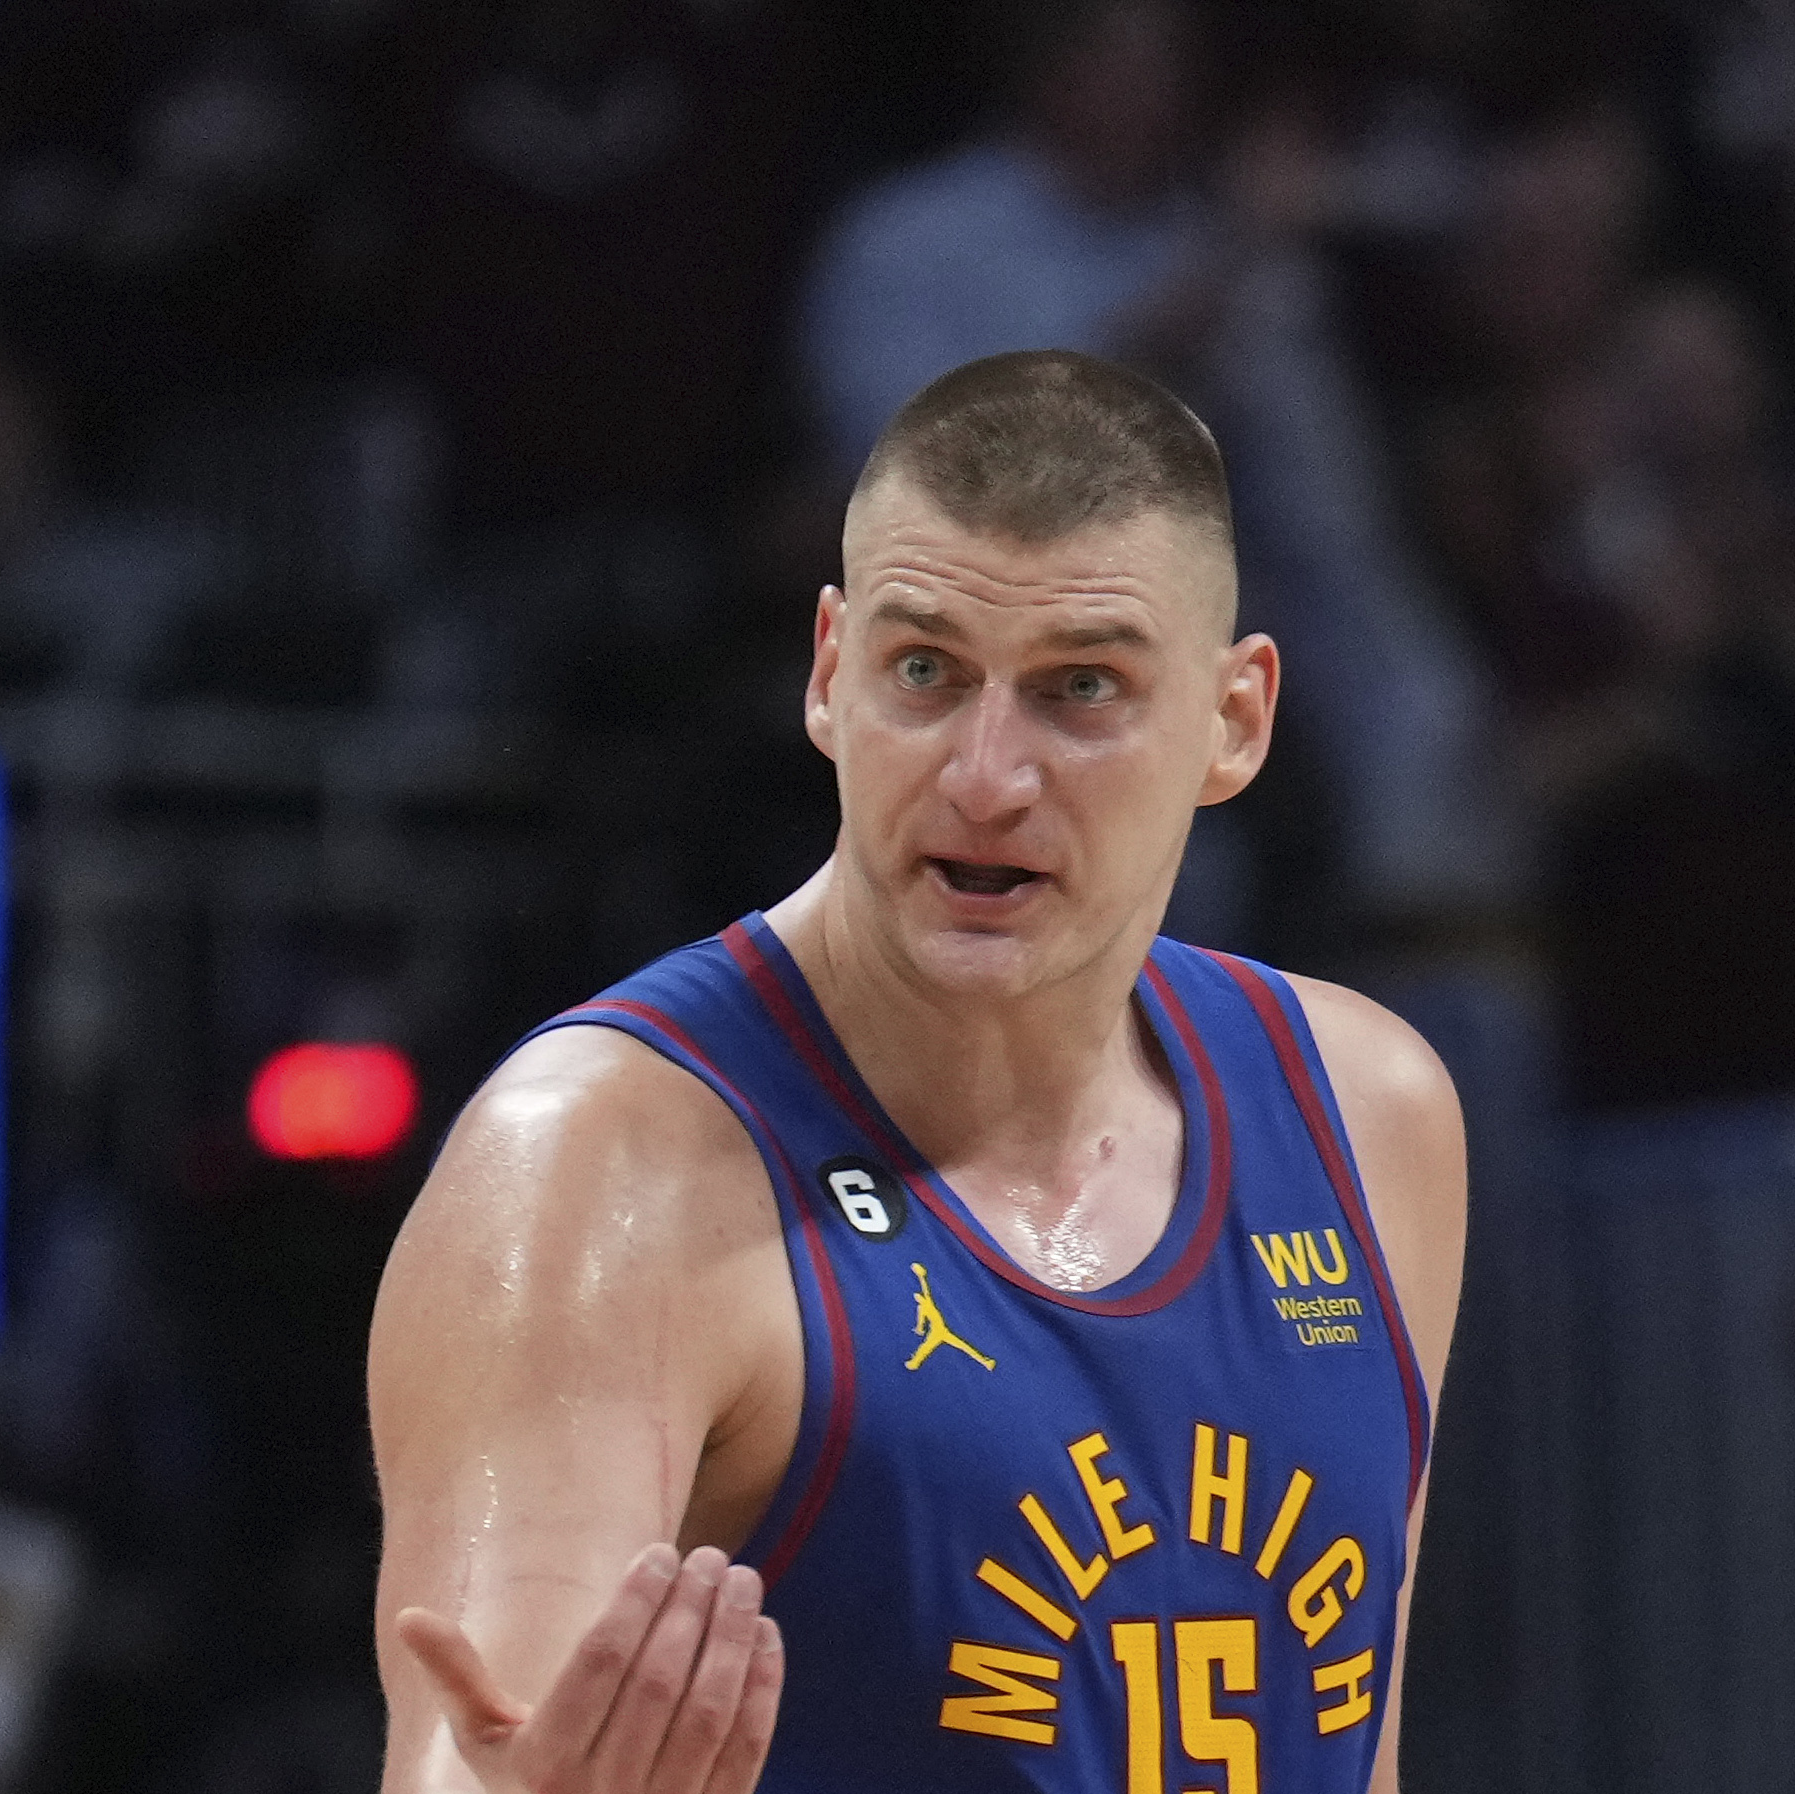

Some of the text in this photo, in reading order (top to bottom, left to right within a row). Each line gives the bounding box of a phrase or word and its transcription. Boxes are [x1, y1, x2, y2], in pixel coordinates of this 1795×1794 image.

[828, 1169, 891, 1233] 6
[1250, 1228, 1349, 1289] WU
[1272, 1295, 1363, 1321] Western
[1296, 1319, 1360, 1346] Union
[939, 1422, 1375, 1746] MILE HIGH
